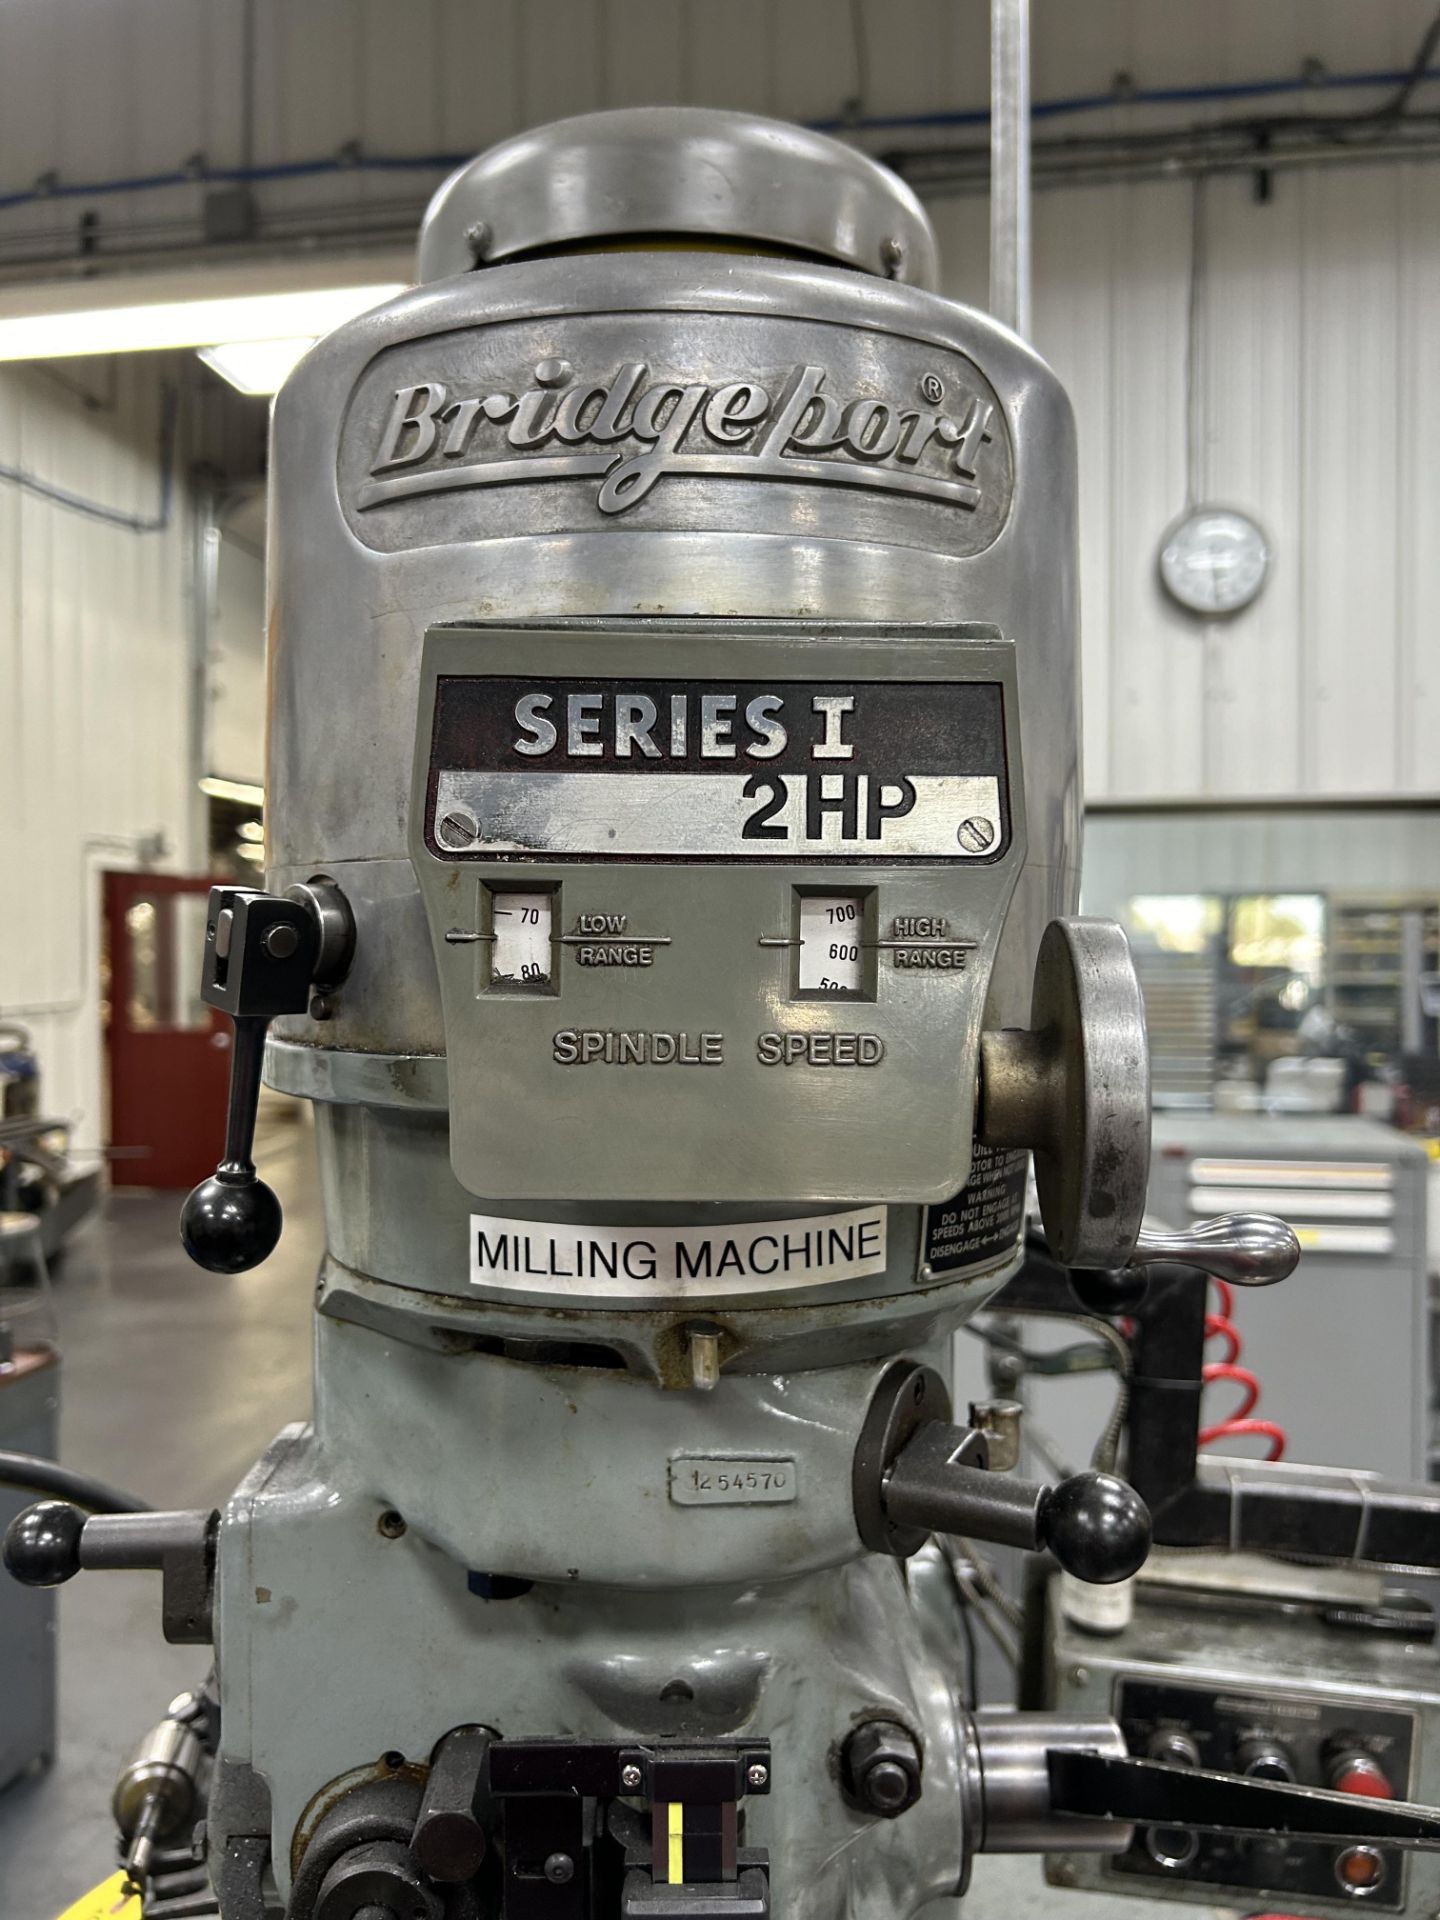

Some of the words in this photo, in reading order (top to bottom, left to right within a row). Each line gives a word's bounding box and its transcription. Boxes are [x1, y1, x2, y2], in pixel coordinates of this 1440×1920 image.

[368, 356, 997, 516] Bridgeport
[513, 694, 788, 759] SERIES
[811, 695, 854, 760] I
[521, 907, 539, 925] 70
[579, 914, 626, 934] LOW
[826, 904, 856, 924] 700
[893, 917, 946, 937] HIGH
[579, 946, 653, 966] RANGE
[829, 943, 858, 962] 600
[894, 949, 966, 969] RANGE
[553, 1031, 724, 1064] SPINDLE
[757, 1033, 884, 1065] SPEED
[941, 1211, 957, 1226] DO
[961, 1206, 980, 1222] NOT
[932, 1223, 965, 1240] SPEEDS
[967, 1213, 994, 1233] ABOVE
[478, 1231, 658, 1280] MILLING
[675, 1219, 881, 1279] MACHINE
[930, 1236, 980, 1259] DISENGAGE
